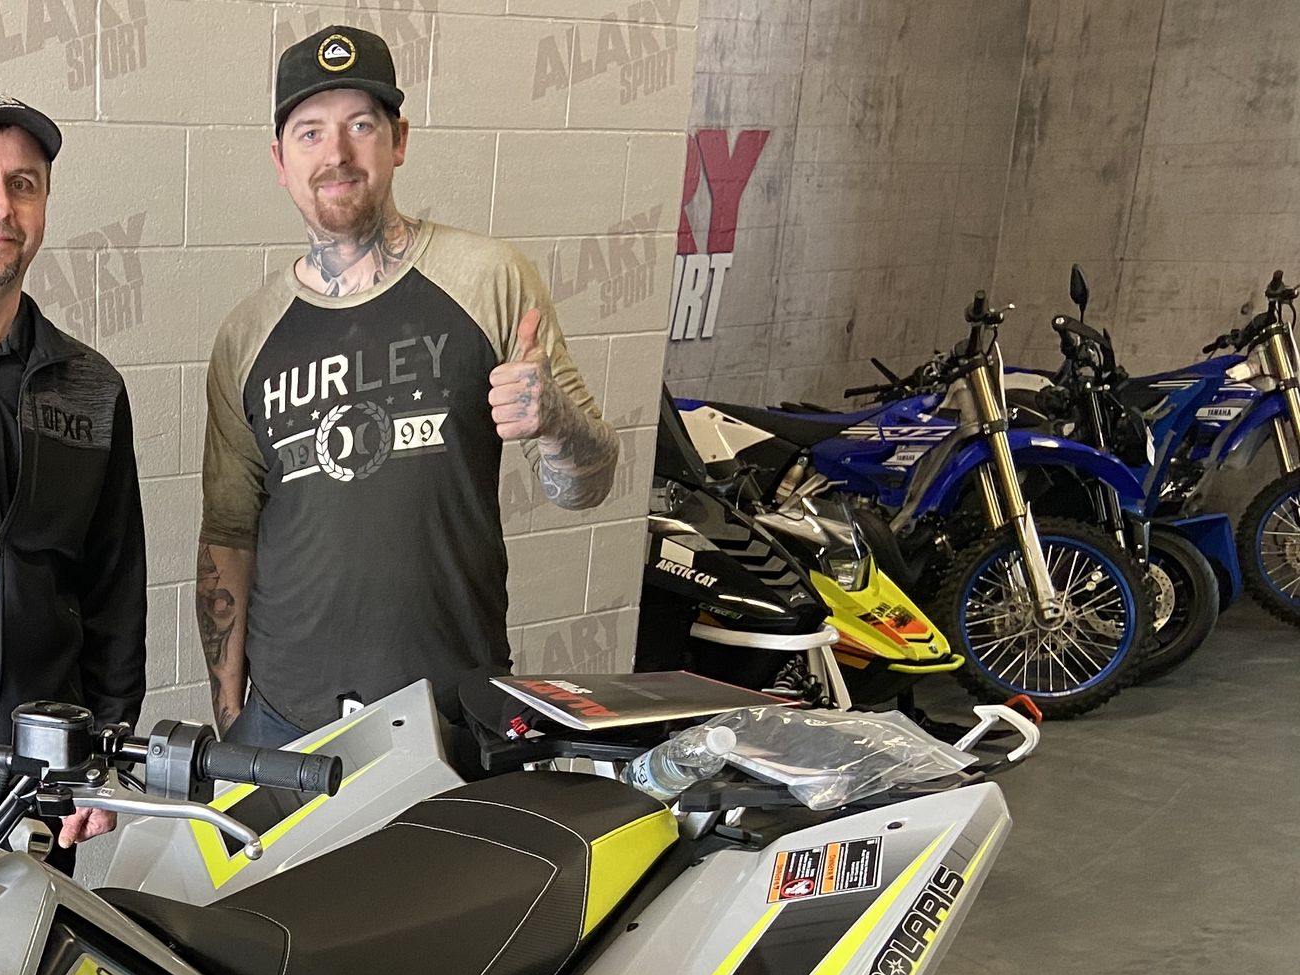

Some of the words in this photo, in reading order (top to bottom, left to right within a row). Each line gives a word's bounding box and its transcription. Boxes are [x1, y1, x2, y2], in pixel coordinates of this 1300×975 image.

[65, 17, 149, 91] SPORT
[531, 0, 681, 101] ALARY
[620, 50, 678, 106] SPORT
[548, 203, 663, 304] LARY
[601, 267, 655, 321] SPORT
[263, 333, 449, 420] HURLEY
[400, 418, 435, 446] 99
[1206, 409, 1232, 417] YAMAHA
[656, 559, 697, 580] ARCTIC
[694, 573, 718, 588] CAT
